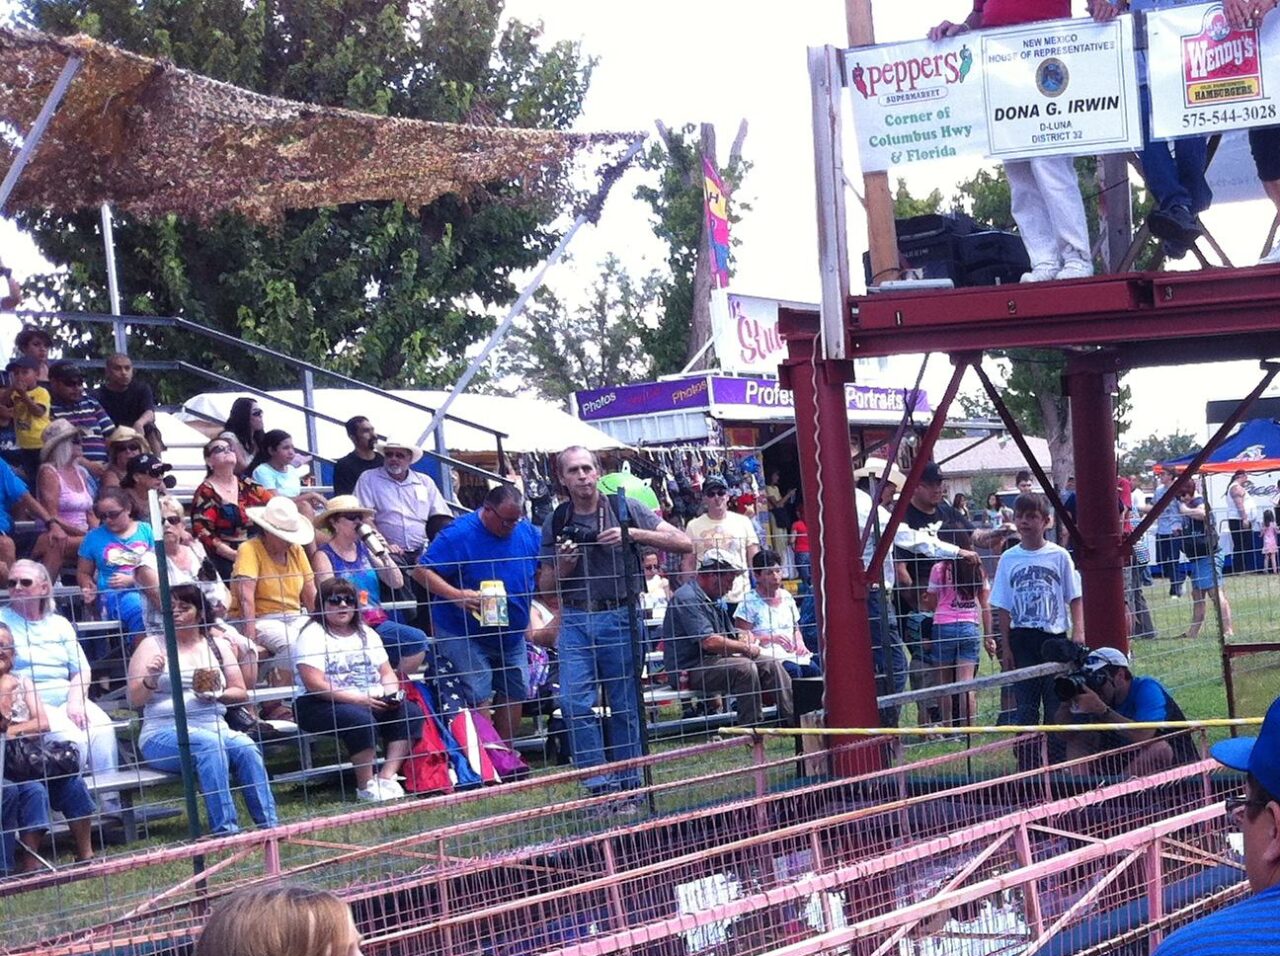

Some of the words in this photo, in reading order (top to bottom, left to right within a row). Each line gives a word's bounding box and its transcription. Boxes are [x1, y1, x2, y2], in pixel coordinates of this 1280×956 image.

[1023, 39, 1042, 48] NEW
[1044, 34, 1078, 45] MEXICO
[1020, 50, 1031, 59] OF
[1187, 36, 1254, 78] Wendy's
[886, 89, 940, 103] SUPERMARKET
[885, 111, 933, 126] Corner
[936, 106, 951, 119] of
[994, 104, 1040, 121] DONA
[1045, 102, 1062, 116] G.
[1068, 96, 1119, 113] IRWIN
[1182, 104, 1277, 128] 575-544-3028
[1040, 120, 1072, 132] D-LUNA
[869, 129, 937, 147] Columbus
[940, 125, 972, 138] Hwy
[1031, 132, 1070, 143] DISTRICT
[891, 151, 902, 164] &
[907, 145, 957, 161] Florida
[1008, 299, 1016, 313] 2
[582, 392, 617, 416] Photos
[671, 380, 708, 404] Photos
[745, 381, 794, 406] Profes
[846, 386, 904, 410] Portraits
